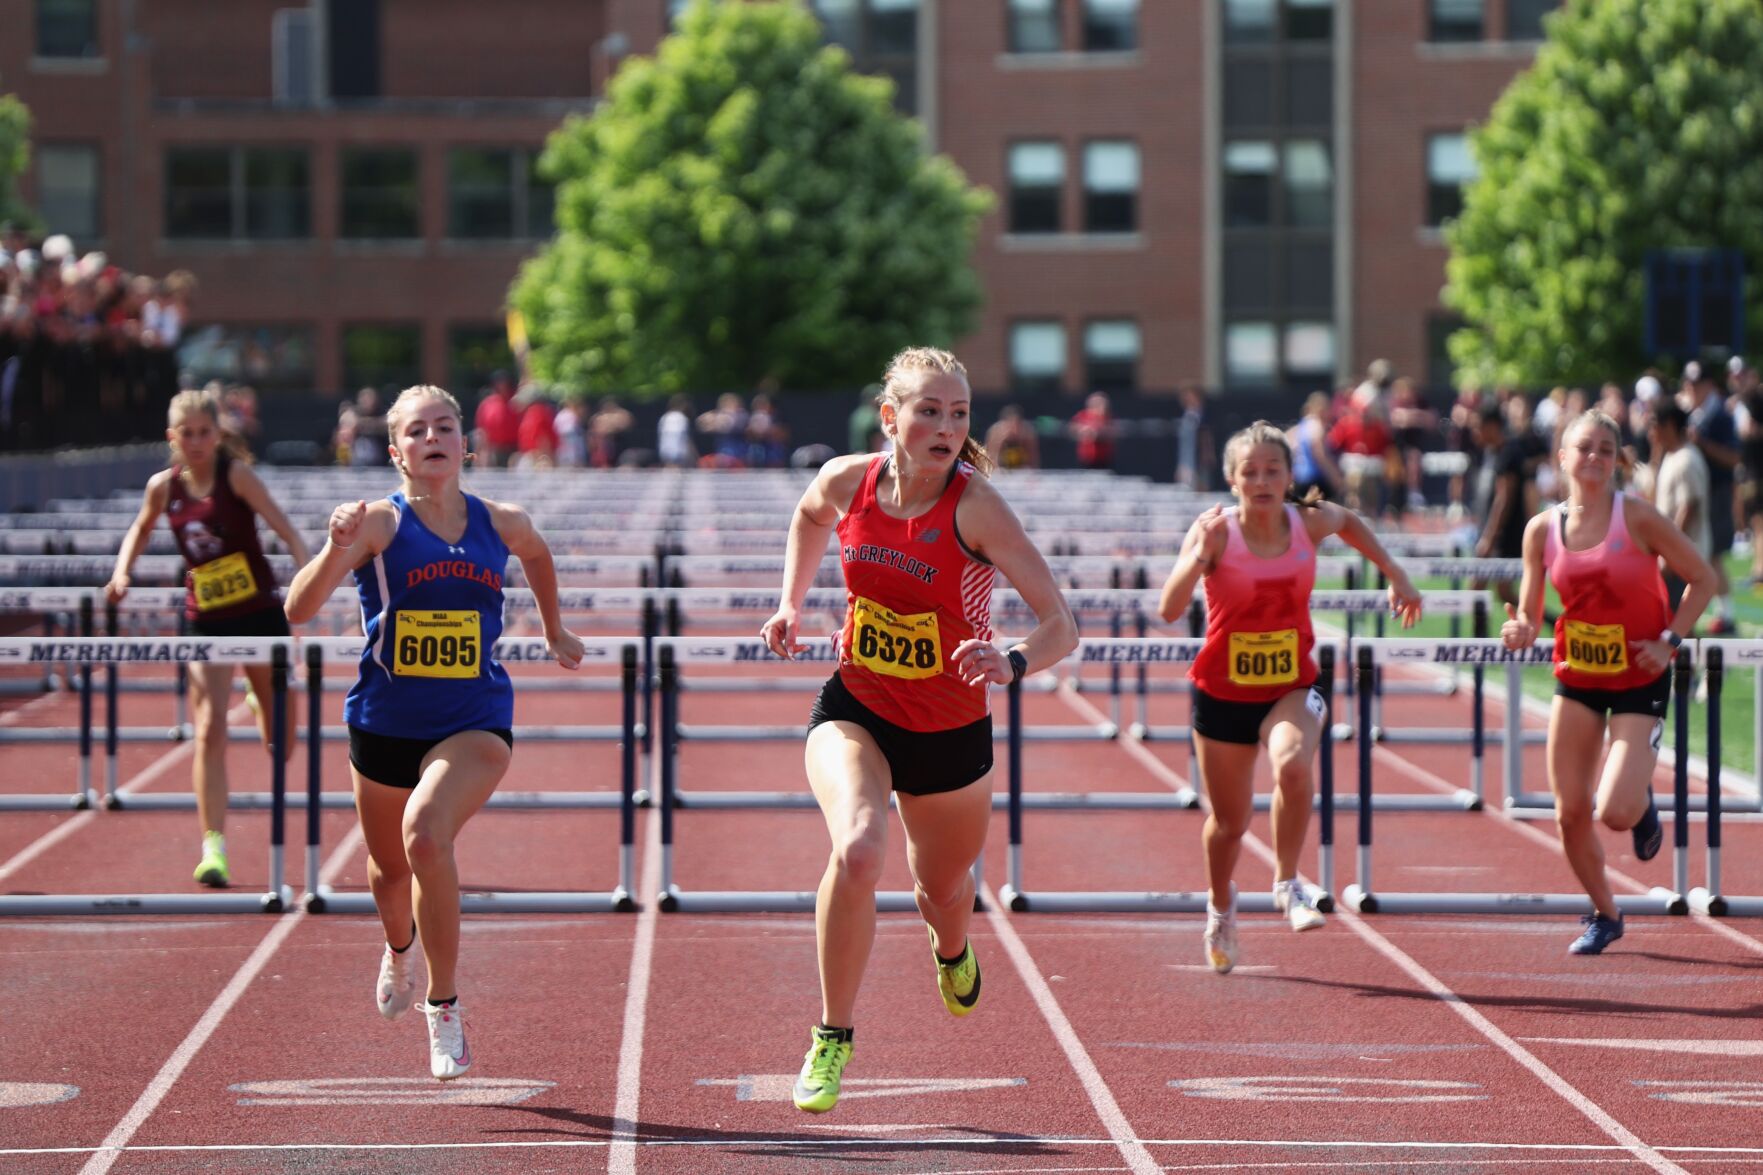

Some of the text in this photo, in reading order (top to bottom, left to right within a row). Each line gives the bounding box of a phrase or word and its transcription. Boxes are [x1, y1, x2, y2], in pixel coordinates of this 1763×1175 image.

[406, 560, 502, 592] DOUGLAS
[844, 544, 940, 584] Mt GREYLOCK
[200, 569, 249, 602] 6025
[29, 643, 212, 661] MERRIMACK
[218, 647, 257, 656] UCS
[399, 635, 476, 667] 6095
[859, 623, 936, 669] 6328
[1236, 648, 1292, 676] 6013
[1387, 648, 1426, 657] UCS
[1570, 637, 1624, 665] 6002
